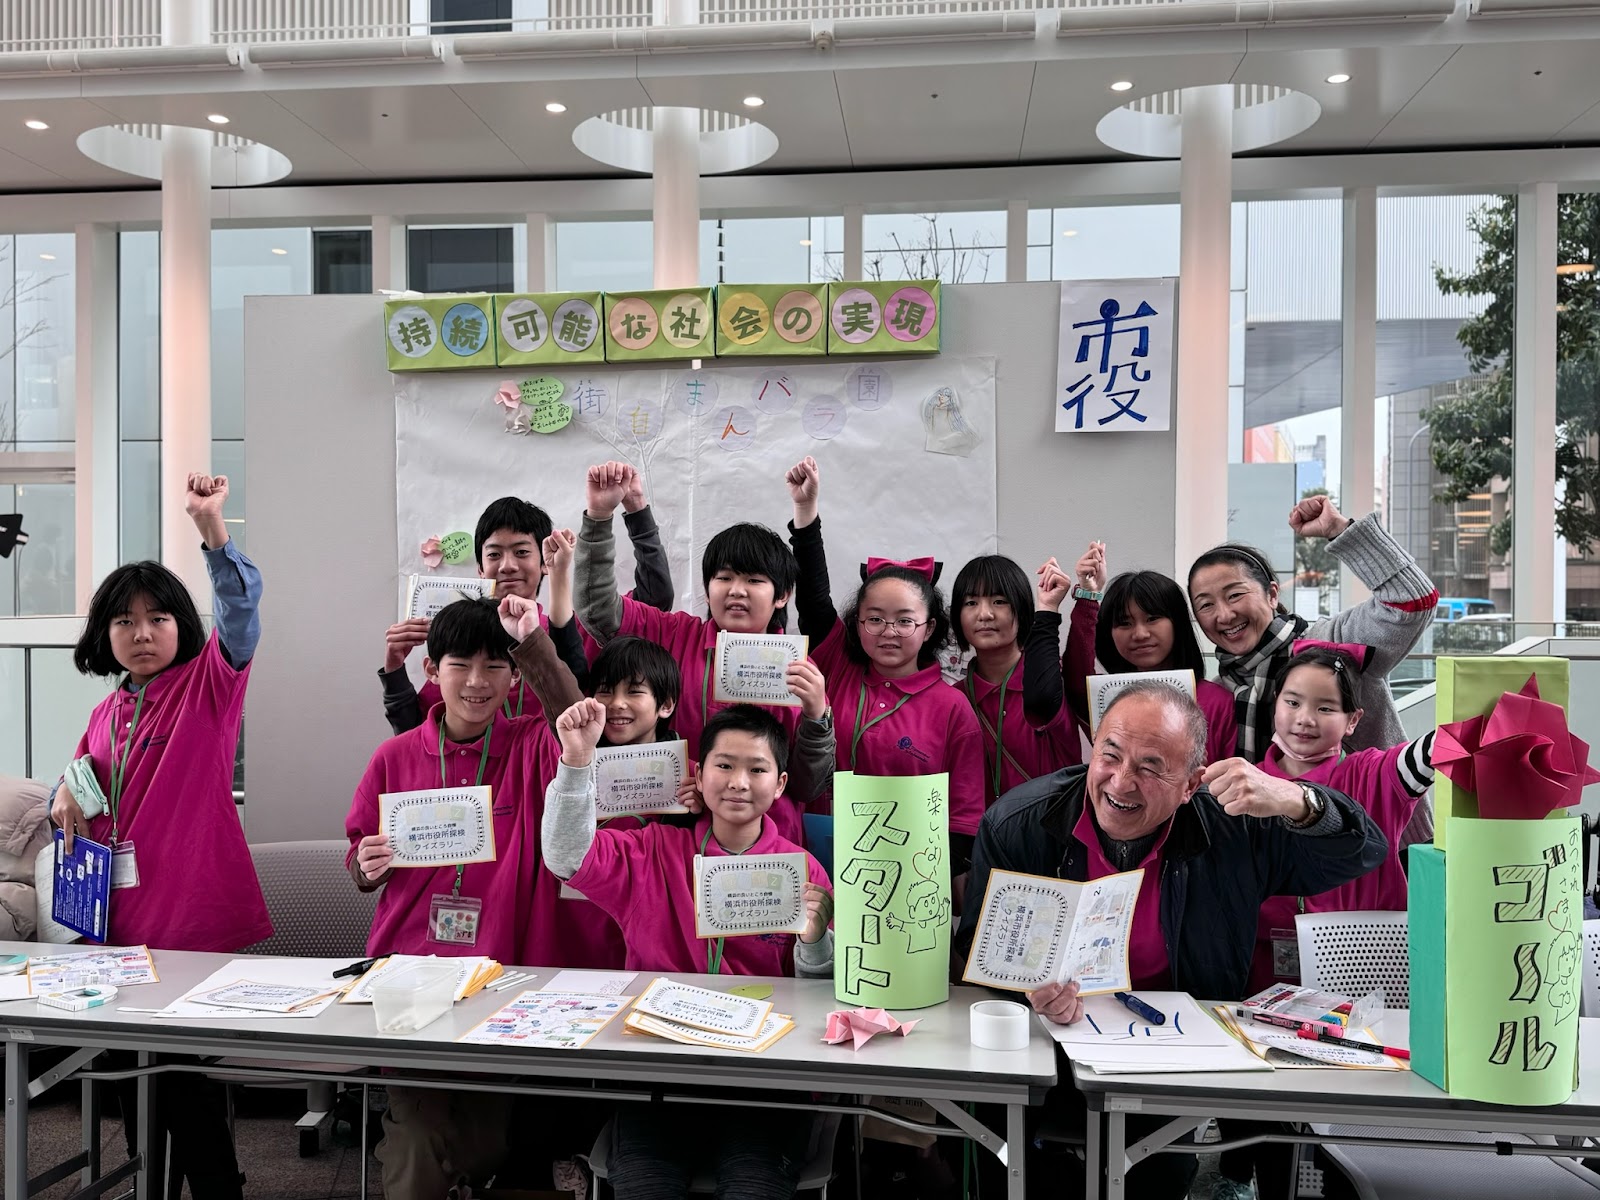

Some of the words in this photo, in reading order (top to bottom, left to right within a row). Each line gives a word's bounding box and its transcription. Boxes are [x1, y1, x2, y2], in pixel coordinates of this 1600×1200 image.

[397, 297, 928, 354] 持続可能な社会の実現
[1062, 298, 1159, 429] 市役
[737, 671, 782, 680] 横浜市役所探検
[740, 680, 779, 688] クイズラリー
[610, 781, 664, 792] 横浜市役所探検
[615, 792, 661, 801] クイズラリー
[408, 829, 466, 842] 横浜市役所探検
[414, 841, 462, 851] クイズラリー
[724, 898, 781, 909] 横浜市役所探検
[840, 801, 910, 995] スタート
[729, 909, 777, 918] クイズラリー
[995, 908, 1012, 956] クイズラリー
[1003, 905, 1026, 963] 横浜市役所探検
[1488, 844, 1566, 1072] ゴール
[1304, 1023, 1310, 1031] 8
